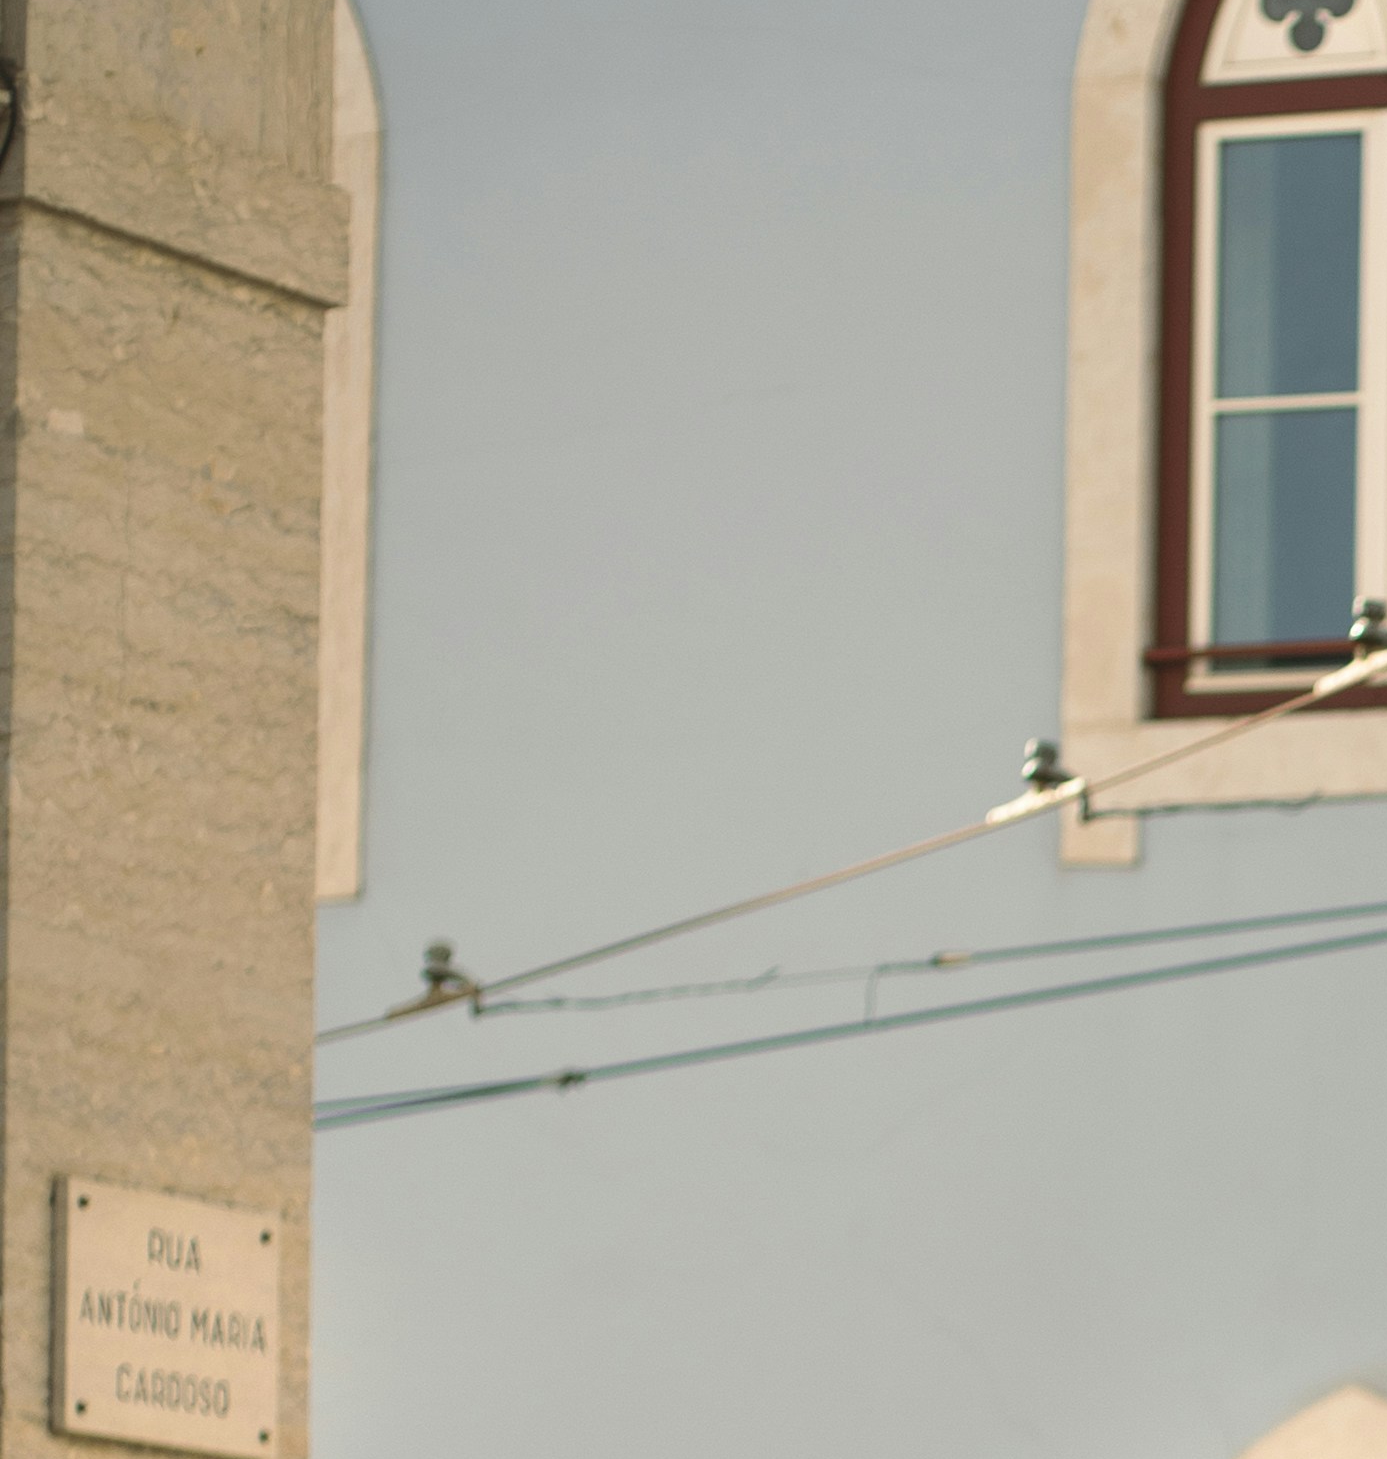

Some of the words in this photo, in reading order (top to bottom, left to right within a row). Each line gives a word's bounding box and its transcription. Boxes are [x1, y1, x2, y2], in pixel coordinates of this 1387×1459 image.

[147, 1226, 202, 1274] RUA
[78, 1278, 182, 1340] ANTÓNIO
[190, 1306, 267, 1355] MARIA
[114, 1361, 232, 1420] CARDOSO
